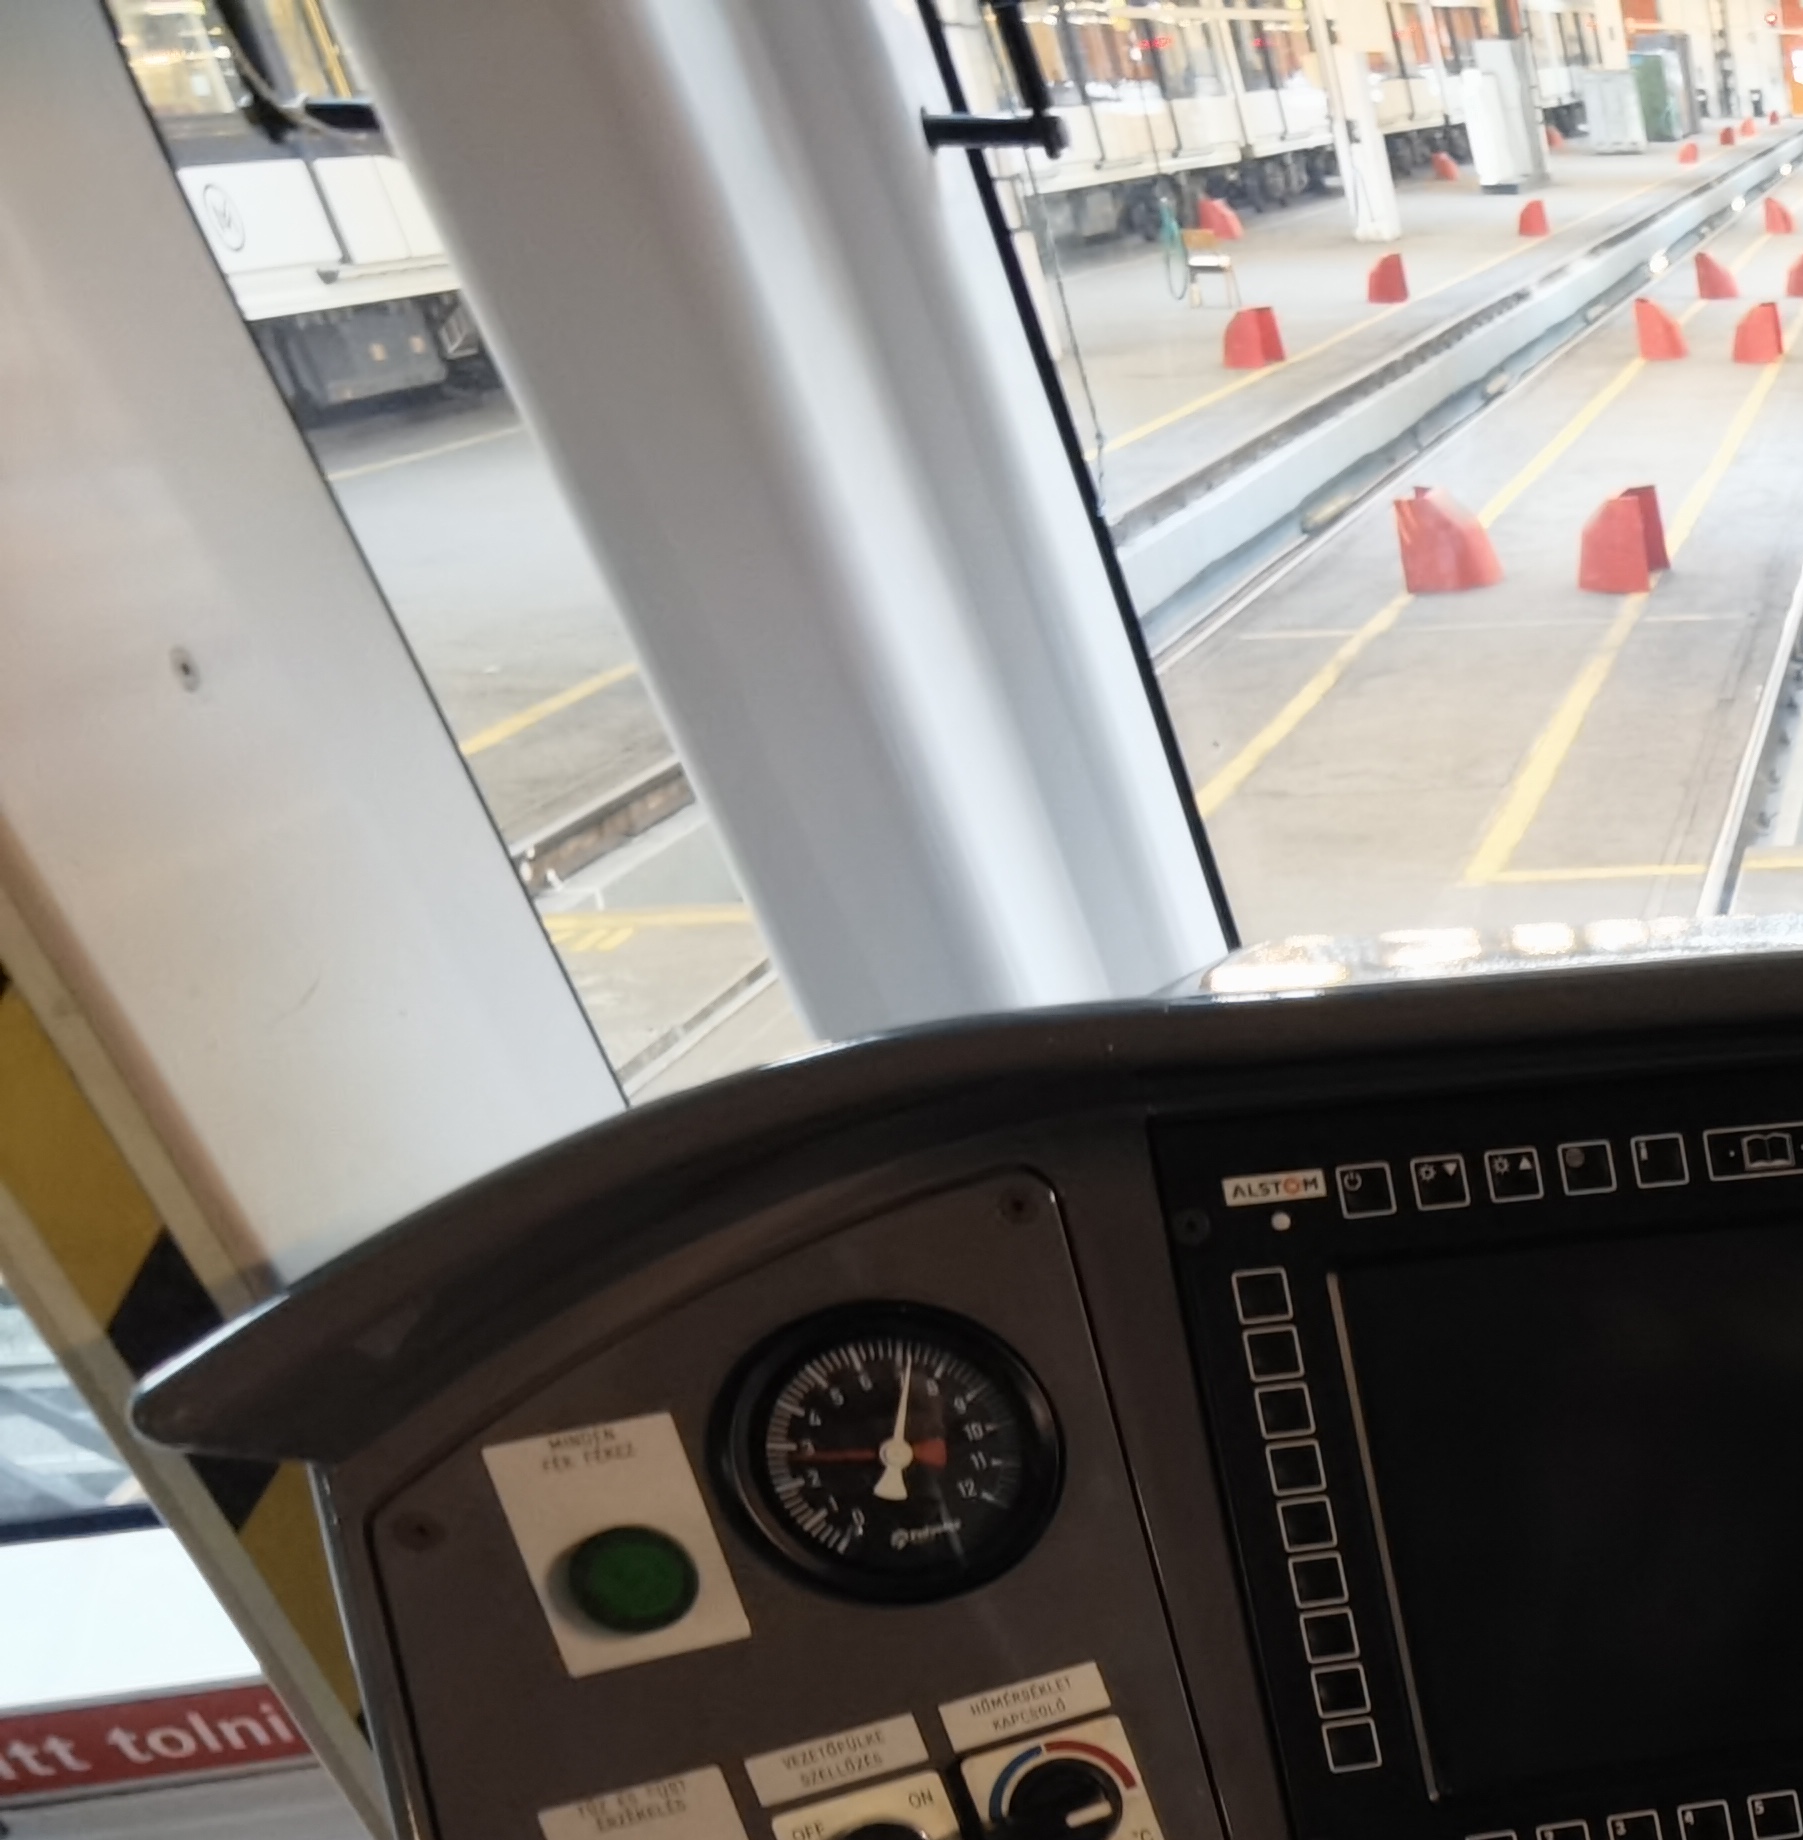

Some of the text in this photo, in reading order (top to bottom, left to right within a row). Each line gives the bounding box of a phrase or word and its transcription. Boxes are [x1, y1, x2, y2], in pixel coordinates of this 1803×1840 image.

[1232, 1177, 1319, 1200] ALSTOM
[809, 1408, 822, 1427] 4
[962, 1421, 985, 1442] 10
[970, 1450, 988, 1471] 11
[807, 1467, 821, 1488] 2
[956, 1478, 978, 1498] 12
[969, 1674, 1073, 1717] HŐMÉRSÉKLET
[992, 1697, 1067, 1732] KAPCSOLÓ
[106, 1700, 297, 1764] tolni
[908, 1787, 935, 1807] ON
[1753, 1799, 1766, 1816] 5
[1683, 1810, 1695, 1825] 4
[1614, 1820, 1627, 1837] 3
